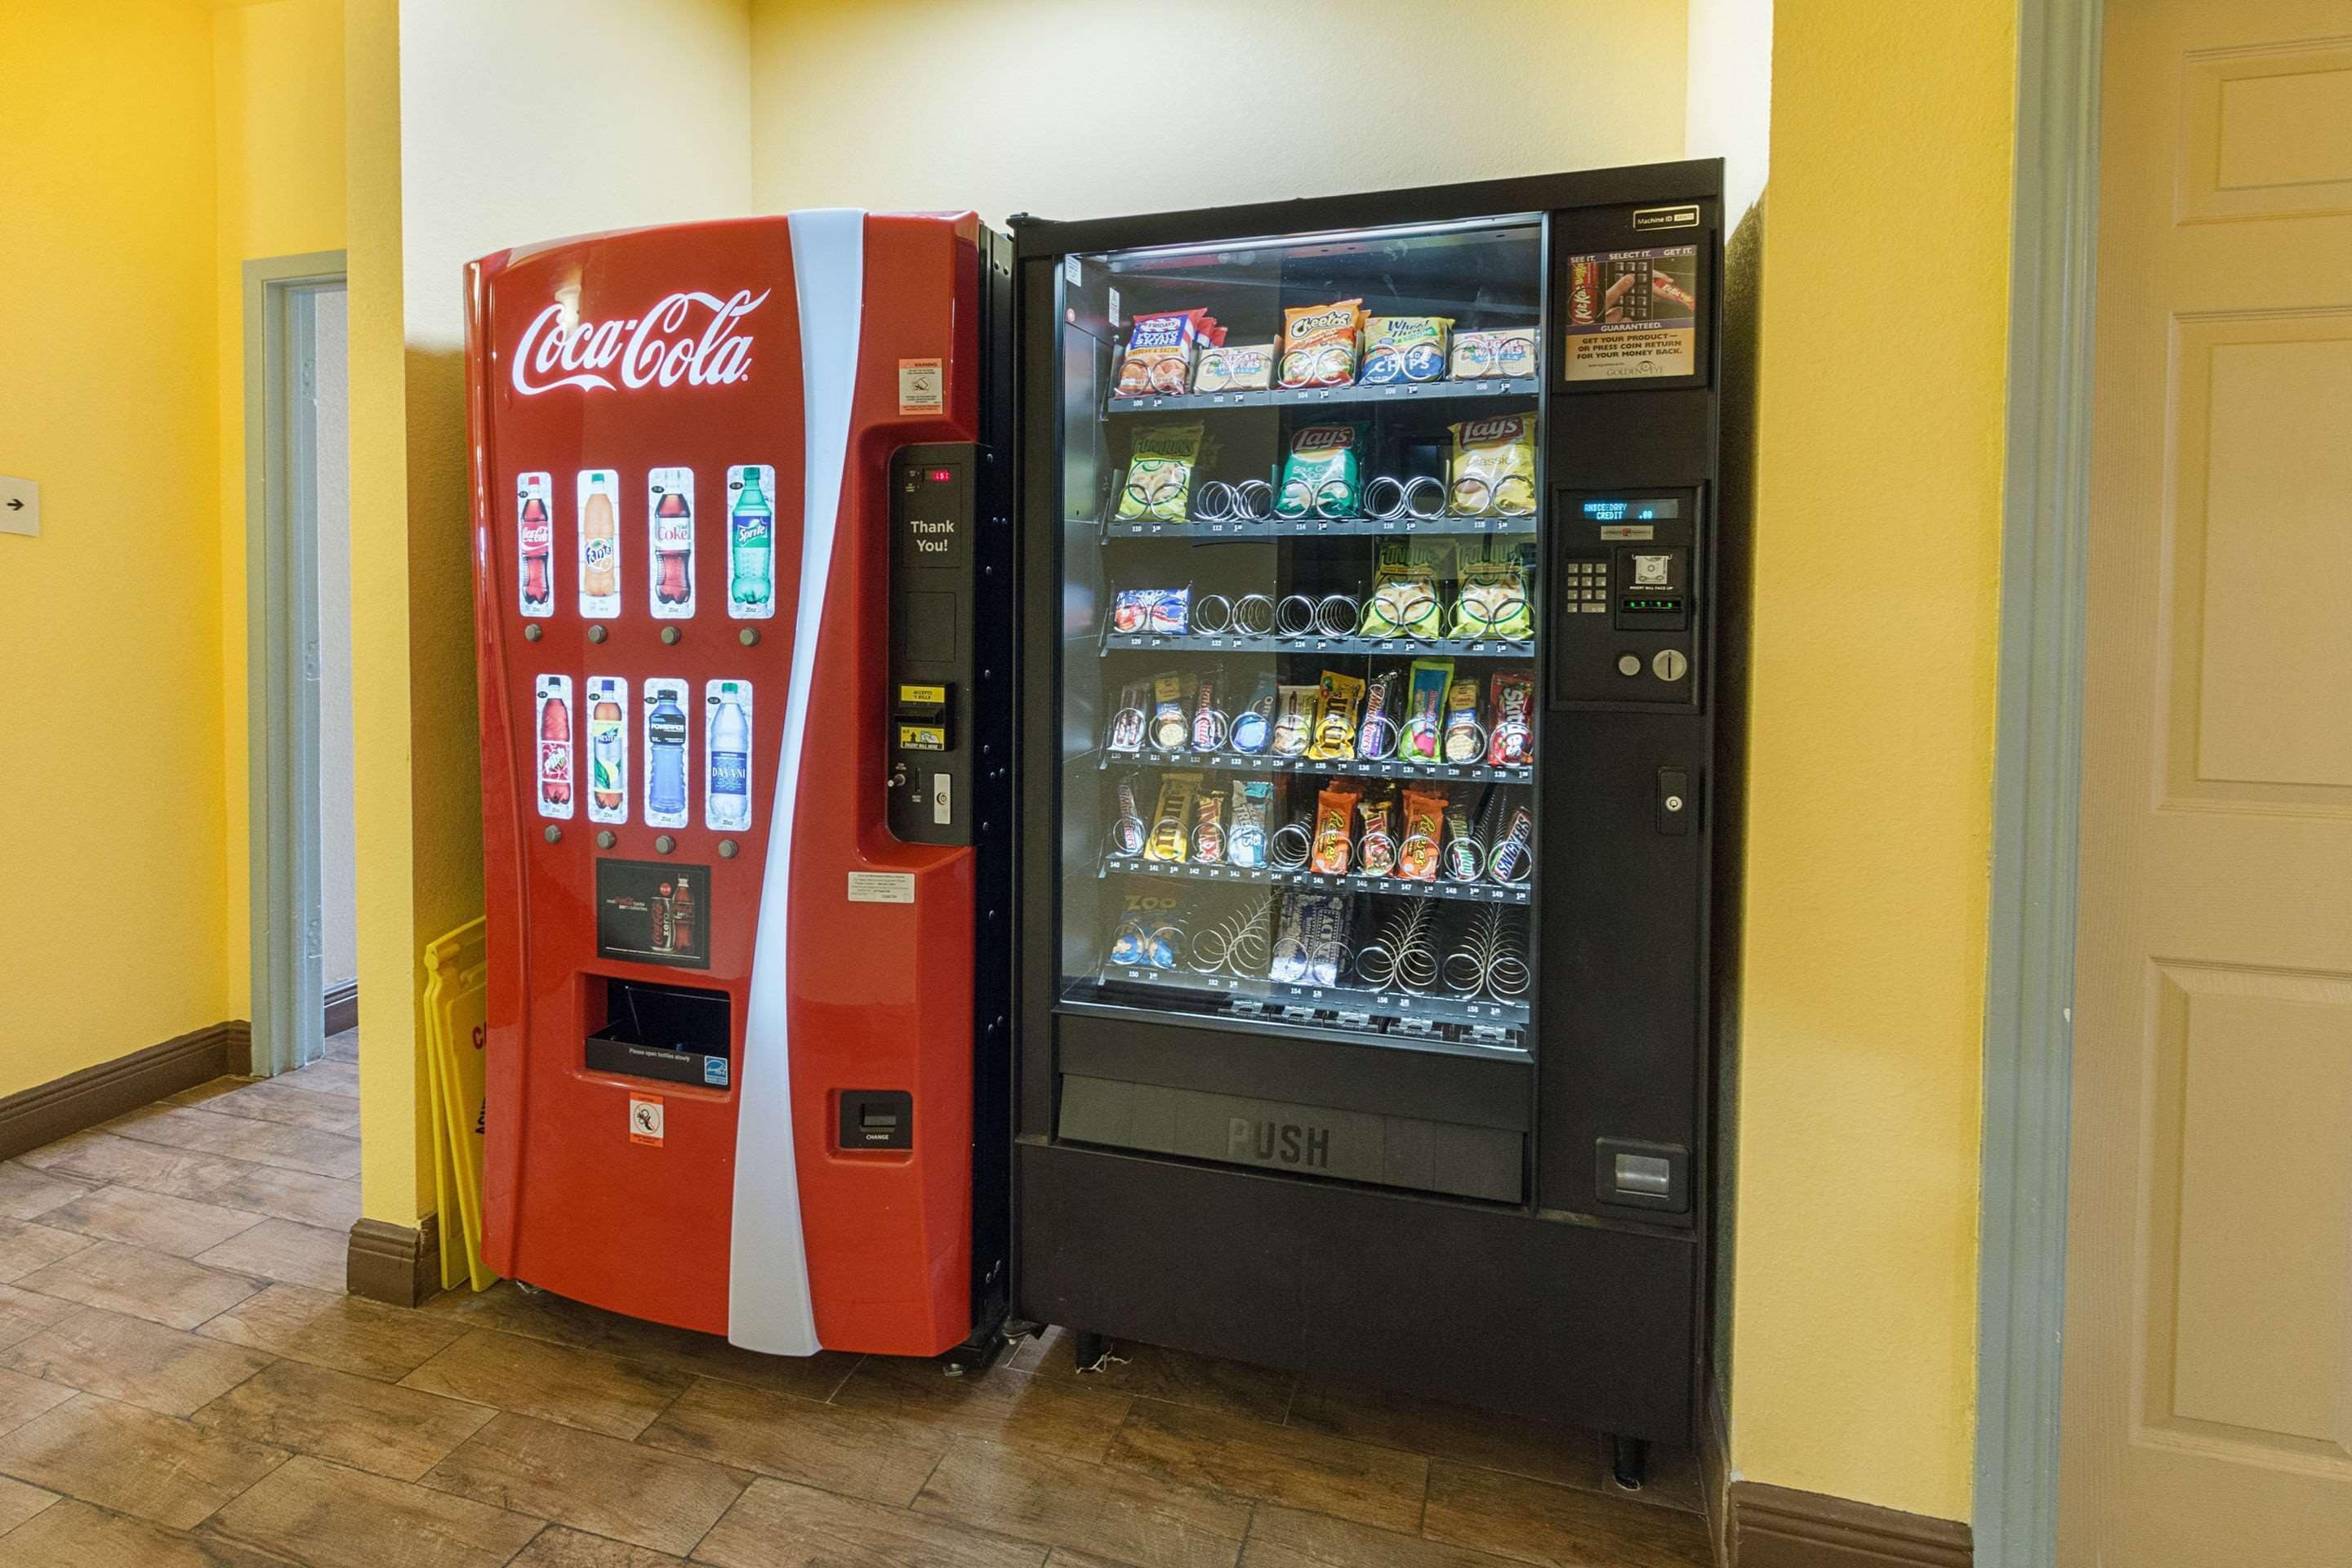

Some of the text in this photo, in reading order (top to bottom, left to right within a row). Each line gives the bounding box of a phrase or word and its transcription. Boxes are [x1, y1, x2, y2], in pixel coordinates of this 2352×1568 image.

[1637, 216, 1664, 225] Machine
[1609, 252, 1641, 261] SELECT
[1664, 248, 1682, 256] GET
[1291, 311, 1351, 339] Cheetos
[1601, 323, 1661, 332] GUARANTEED.
[512, 287, 771, 395] Coca-Cola
[1655, 348, 1683, 356] BACK.
[1374, 359, 1430, 373] CHPS
[1596, 511, 1624, 519] CREDIT
[657, 525, 688, 541] Coke
[910, 519, 955, 533] Thank
[738, 524, 766, 543] Sprite
[916, 539, 948, 552] You!
[1496, 816, 1532, 877] SNICKERS
[662, 912, 670, 937] zero
[657, 1051, 674, 1059] bottles
[675, 1054, 690, 1062] slowly
[1227, 1117, 1330, 1169] PUSH
